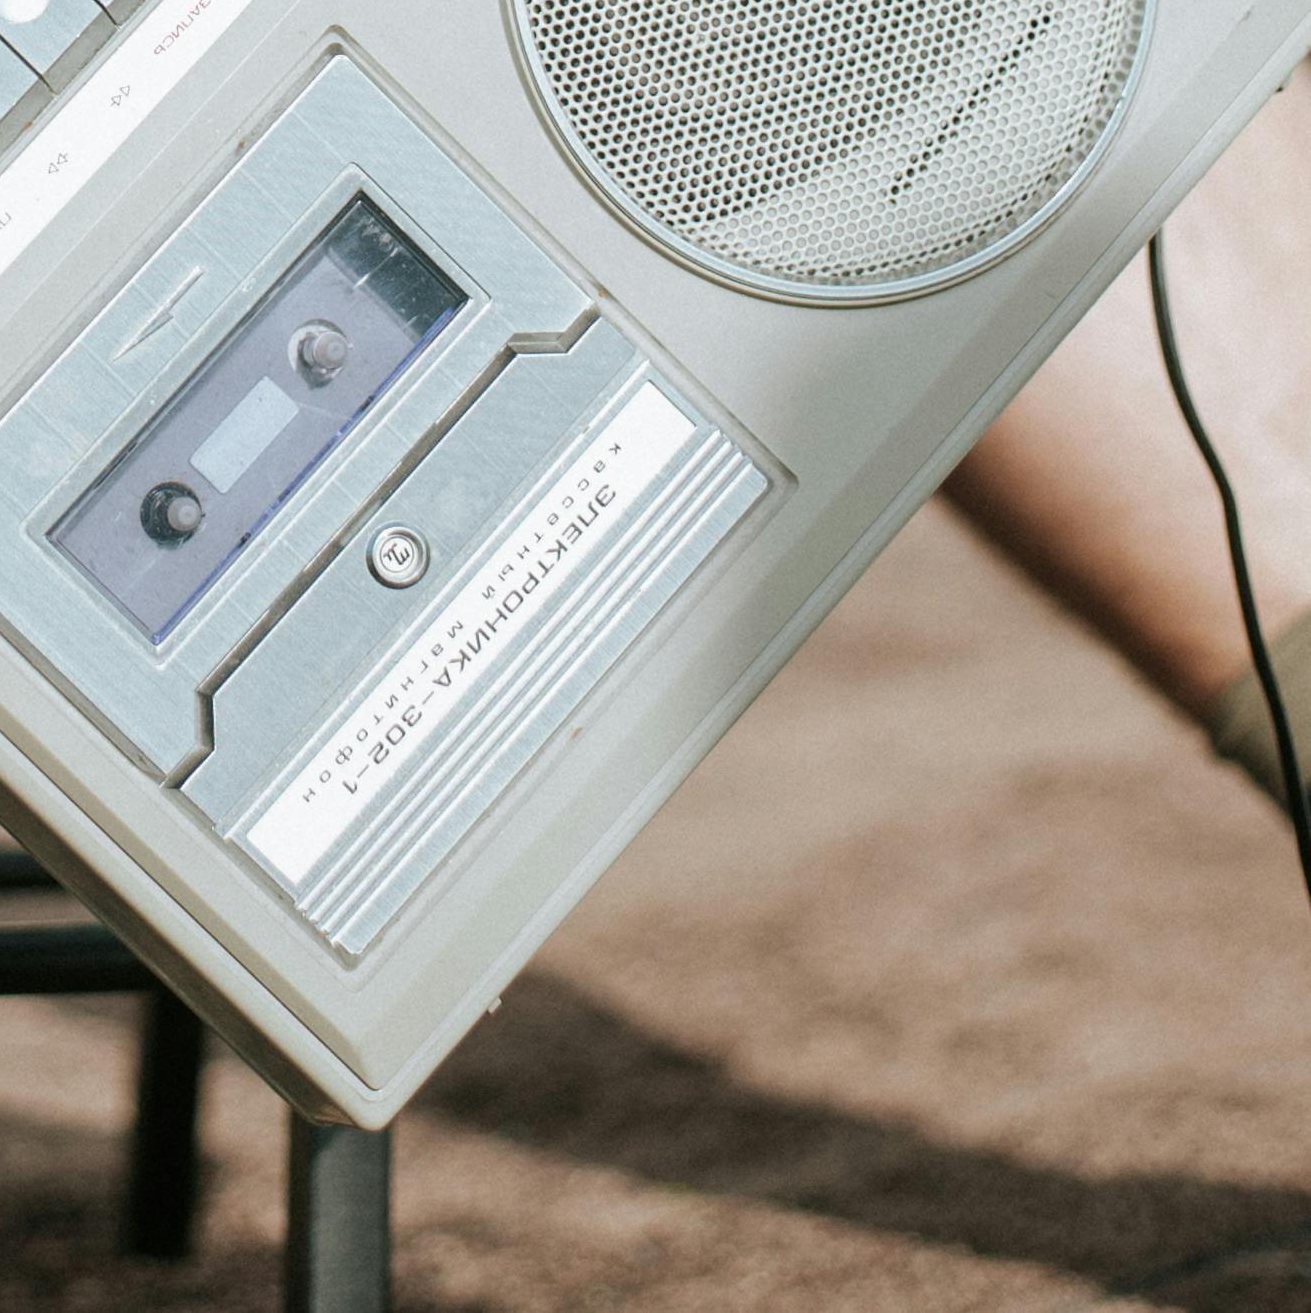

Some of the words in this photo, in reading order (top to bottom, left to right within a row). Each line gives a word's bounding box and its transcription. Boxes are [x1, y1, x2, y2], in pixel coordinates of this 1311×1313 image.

[480, 442, 622, 600] кассетный
[302, 620, 464, 804] магнитофон
[342, 484, 617, 795] ЭЛЕКТРОНИКА-302-1
